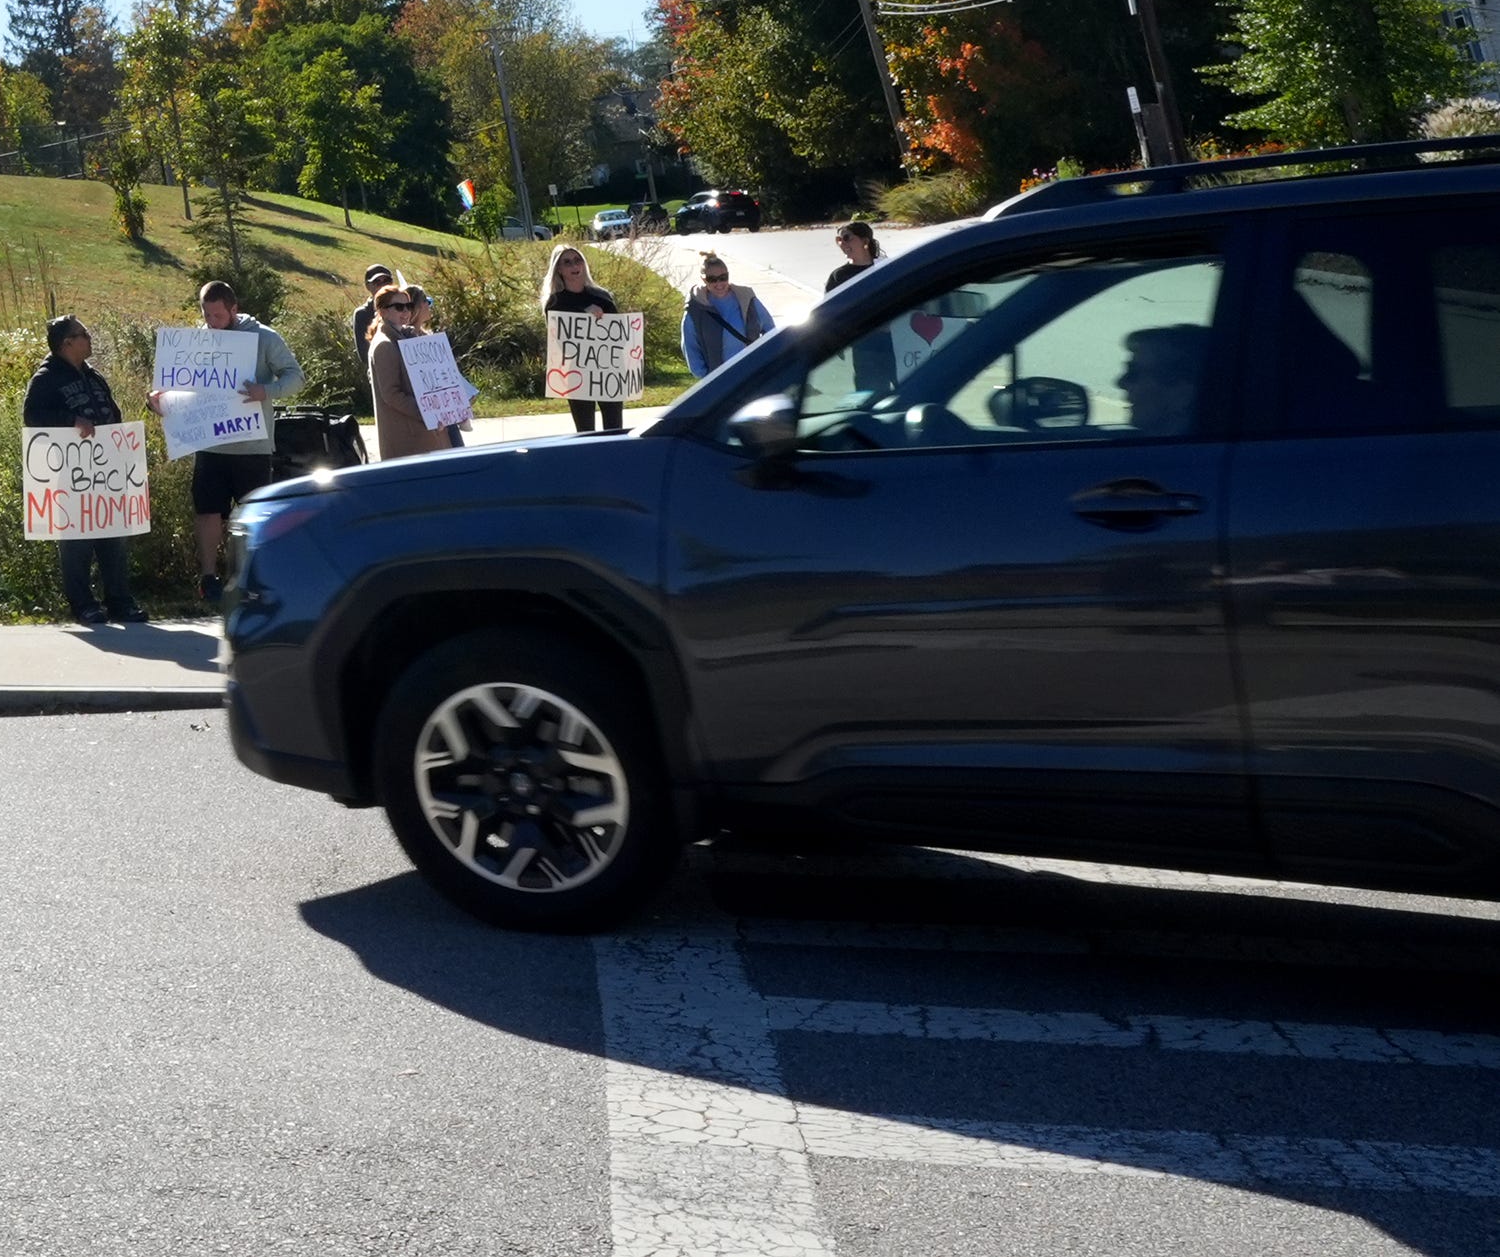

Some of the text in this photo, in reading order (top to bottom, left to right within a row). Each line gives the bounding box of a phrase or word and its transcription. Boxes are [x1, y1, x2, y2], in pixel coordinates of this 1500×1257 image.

[161, 329, 222, 348] NO MAN
[557, 315, 630, 342] NELSON
[174, 350, 233, 367] EXCEPT
[561, 341, 624, 370] PLACE
[161, 367, 238, 390] HOMAN
[589, 359, 644, 399] HOMAN
[213, 412, 261, 436] MARY!
[27, 432, 108, 483] Come
[71, 462, 145, 492] BACK
[27, 480, 150, 534] MS. HOMAN
